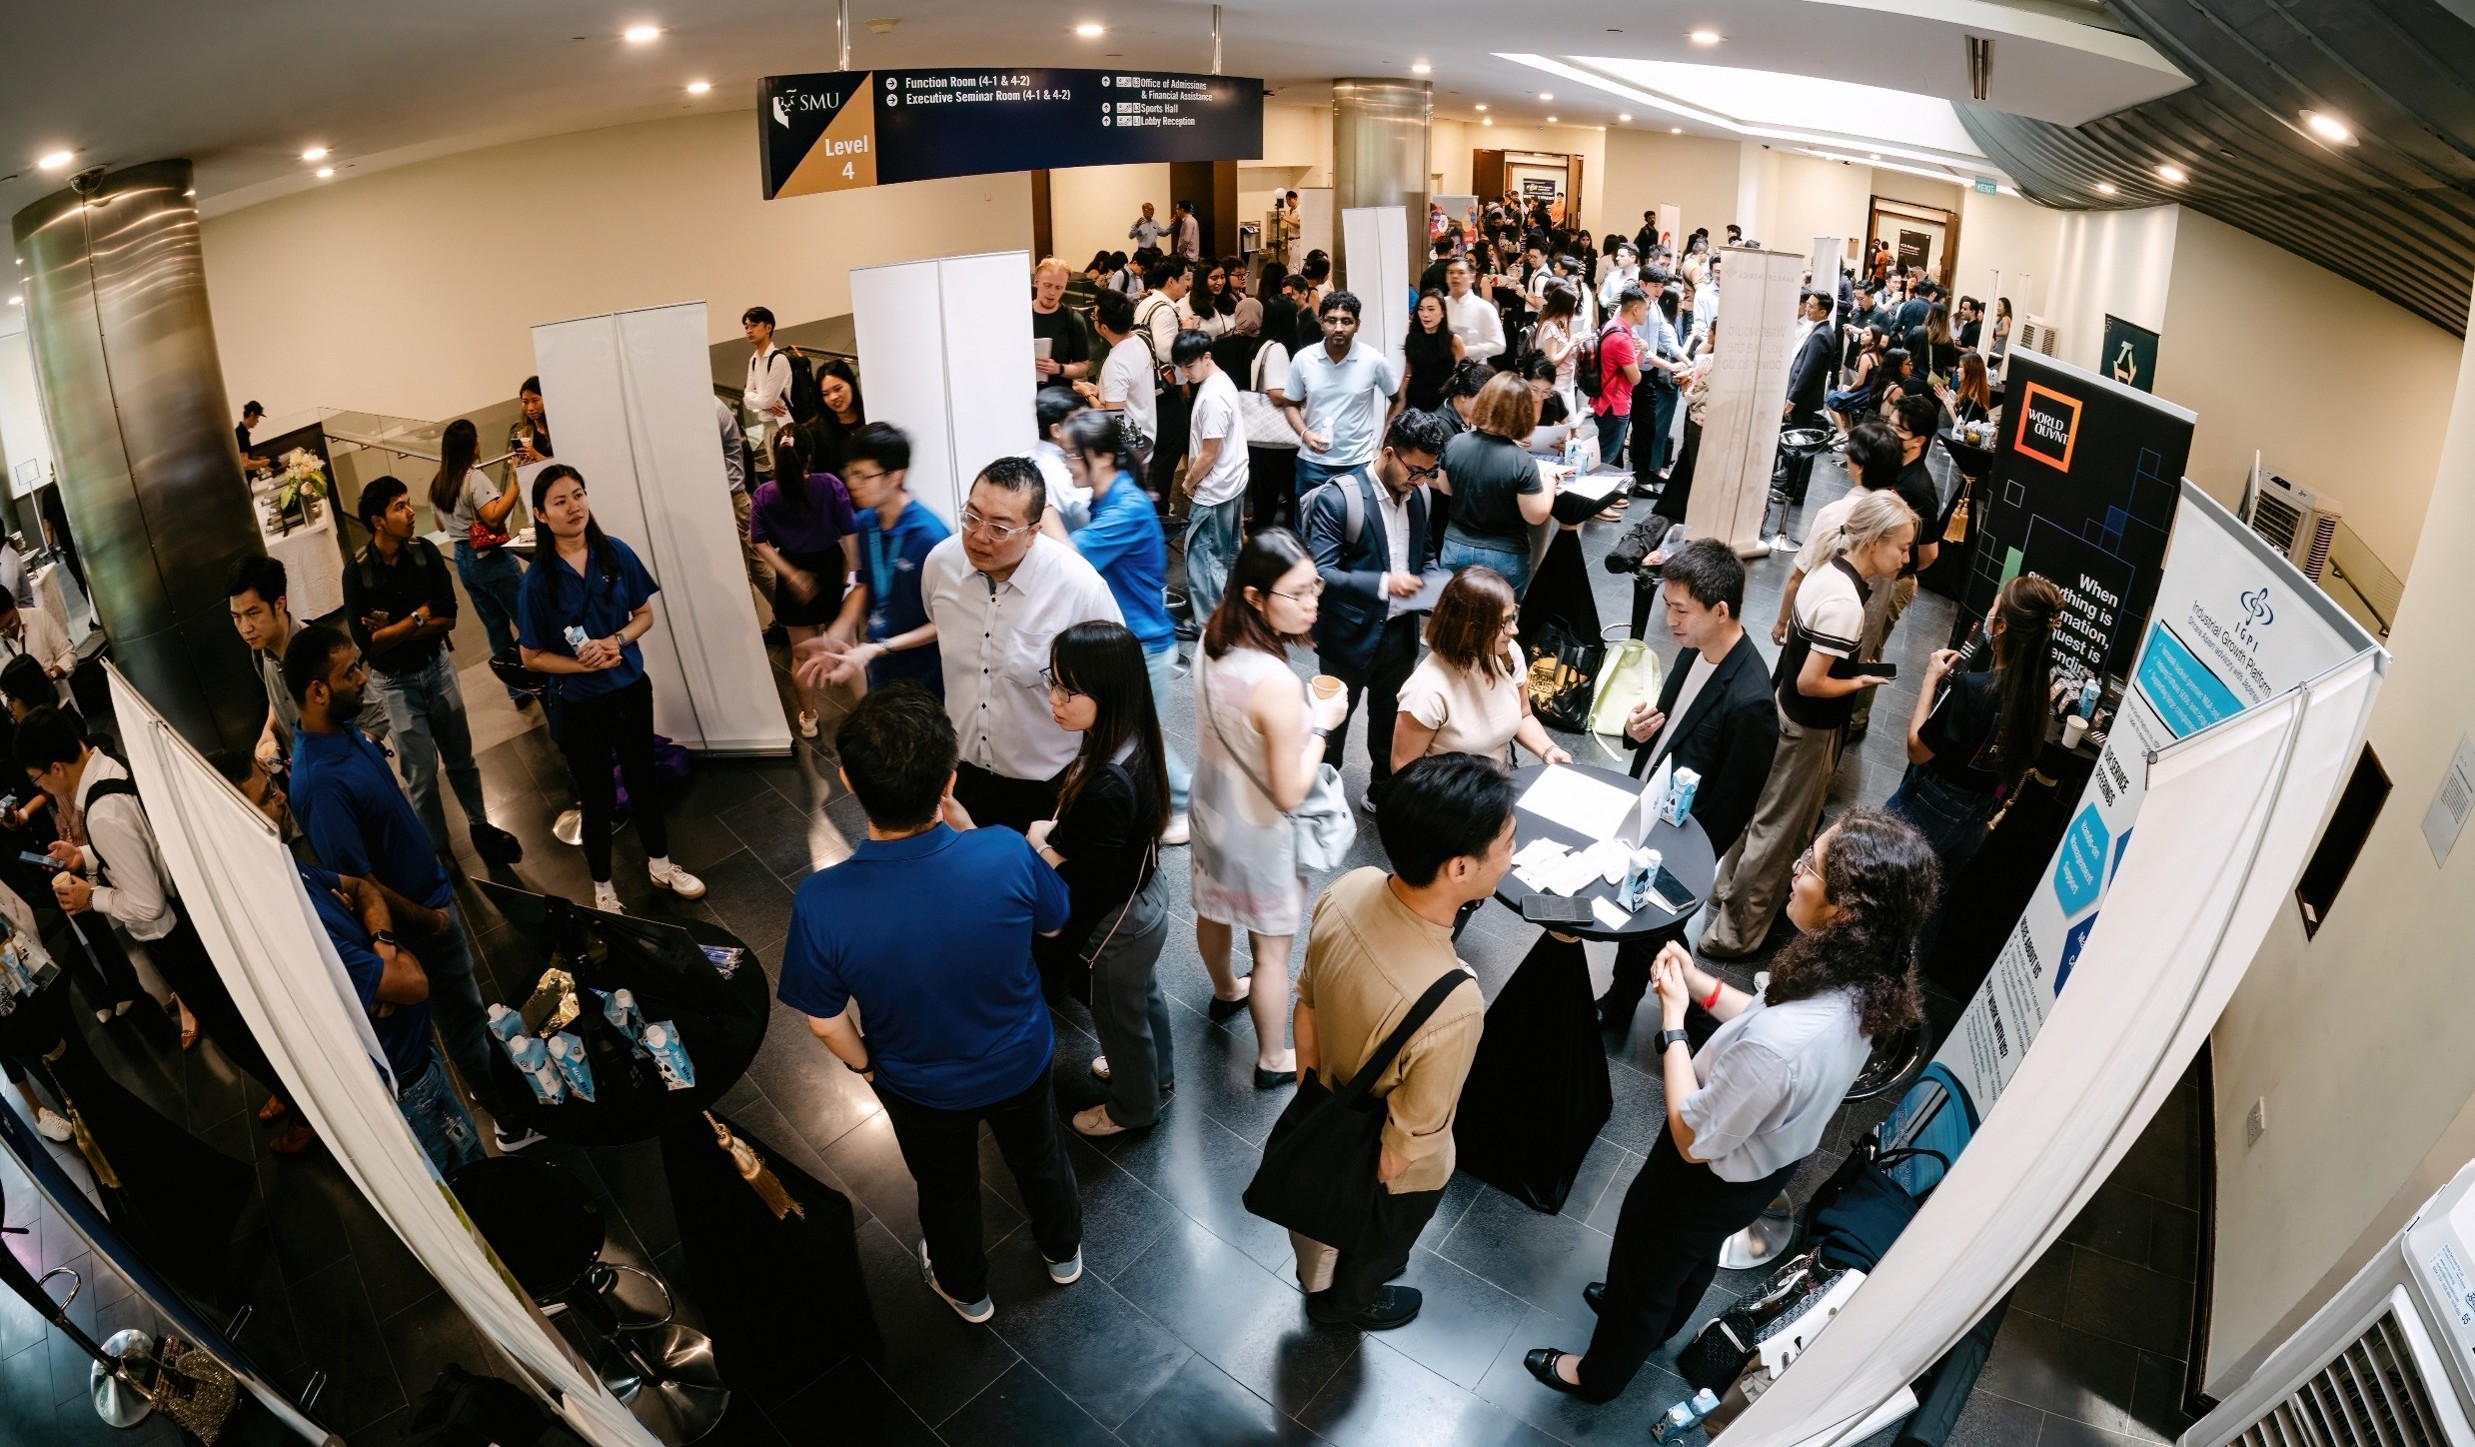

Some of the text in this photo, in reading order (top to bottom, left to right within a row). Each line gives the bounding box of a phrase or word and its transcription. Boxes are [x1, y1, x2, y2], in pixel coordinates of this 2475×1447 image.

[905, 75, 1031, 89] Function Room (4-1 & 4-2)
[1140, 78, 1161, 88] Office
[1163, 79, 1170, 89] of
[1171, 79, 1207, 90] Admissions
[799, 92, 840, 111] SMU
[906, 89, 1071, 105] Executive Seminar Room (4-1 & 4-2)
[1141, 90, 1213, 101] & Financial Assistance
[1141, 103, 1163, 114] Sports
[1164, 103, 1178, 113] Hall
[1141, 116, 1161, 127] Lobby
[1162, 116, 1196, 128] Reception
[824, 134, 868, 157] Level
[841, 161, 855, 180] 4
[2028, 408, 2064, 431] WORLD
[2080, 573, 2118, 608] When
[2099, 608, 2113, 626] is
[2087, 646, 2101, 663] is
[2192, 600, 2272, 699] Industrial Growth Platform
[2110, 757, 2130, 795] SERVICE
[2096, 765, 2116, 807] OFFERINGS
[2024, 937, 2038, 966] ABOUT
[2033, 961, 2043, 979] US
[1988, 993, 1999, 1021] WORK
[1994, 1017, 2006, 1044] WITH
[1999, 1038, 2009, 1059] US?
[2461, 1313, 2471, 1325] 55
